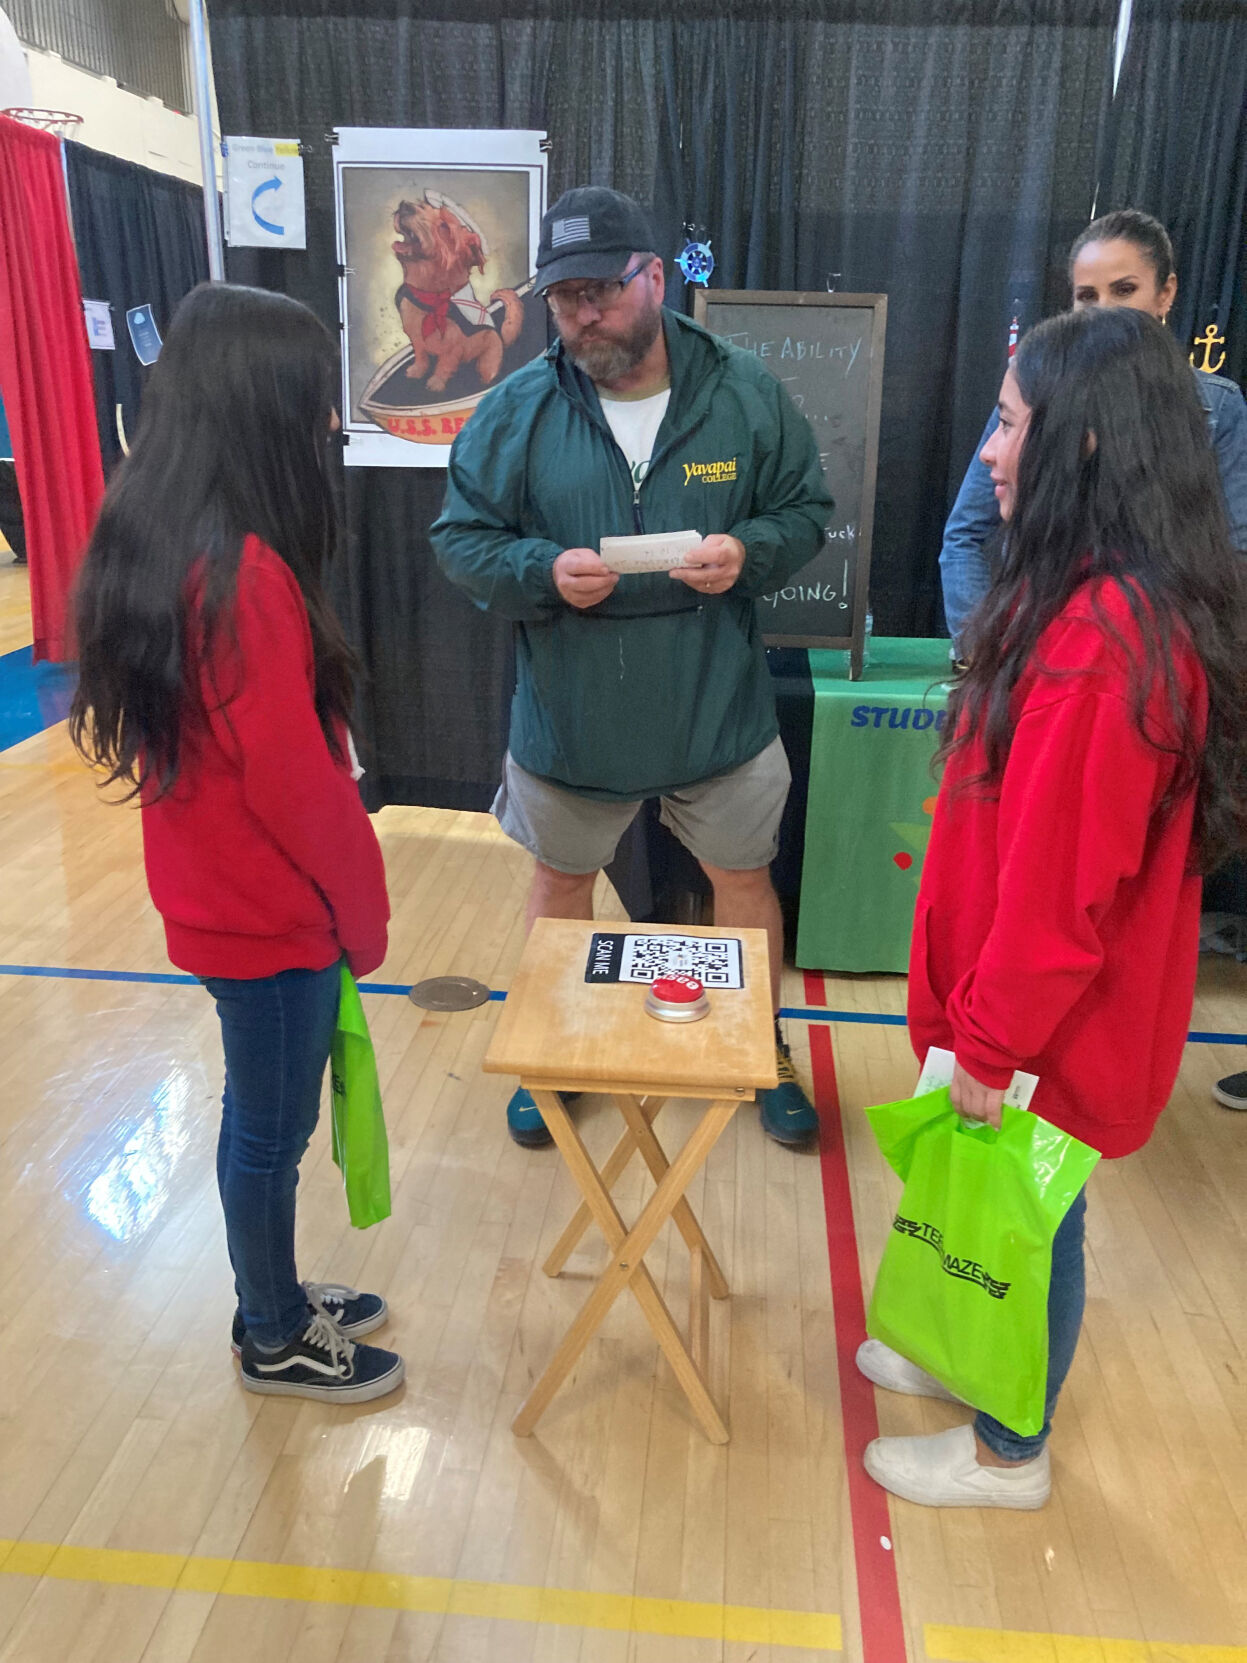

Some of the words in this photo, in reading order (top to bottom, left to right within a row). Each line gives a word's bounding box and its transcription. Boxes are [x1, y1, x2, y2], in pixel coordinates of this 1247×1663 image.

[247, 160, 286, 170] Continue
[780, 336, 863, 379] ABILITY
[702, 472, 737, 483] COLLEGE
[594, 940, 614, 960] SCAN
[591, 962, 611, 975] ME
